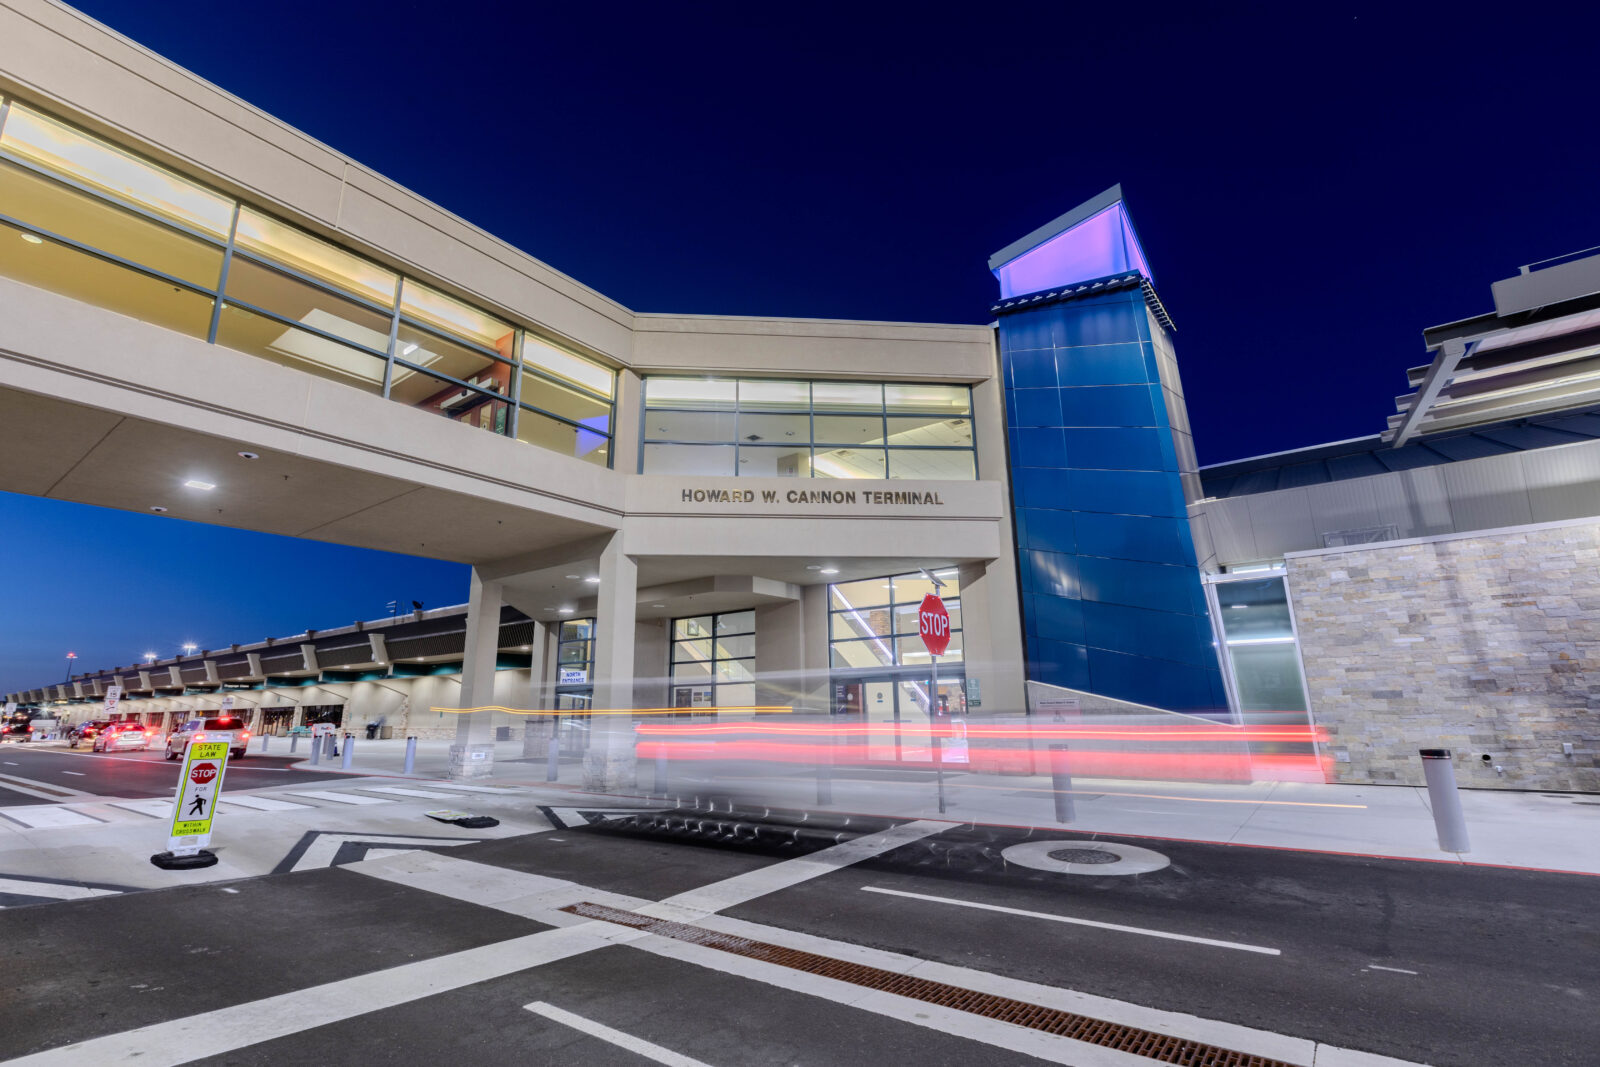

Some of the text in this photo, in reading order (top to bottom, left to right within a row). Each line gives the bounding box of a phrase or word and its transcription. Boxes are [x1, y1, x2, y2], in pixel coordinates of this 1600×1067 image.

[681, 489, 944, 505] HOWARD W. CANNON TERMINAL
[921, 611, 948, 637] STOP
[191, 769, 217, 778] STOP
